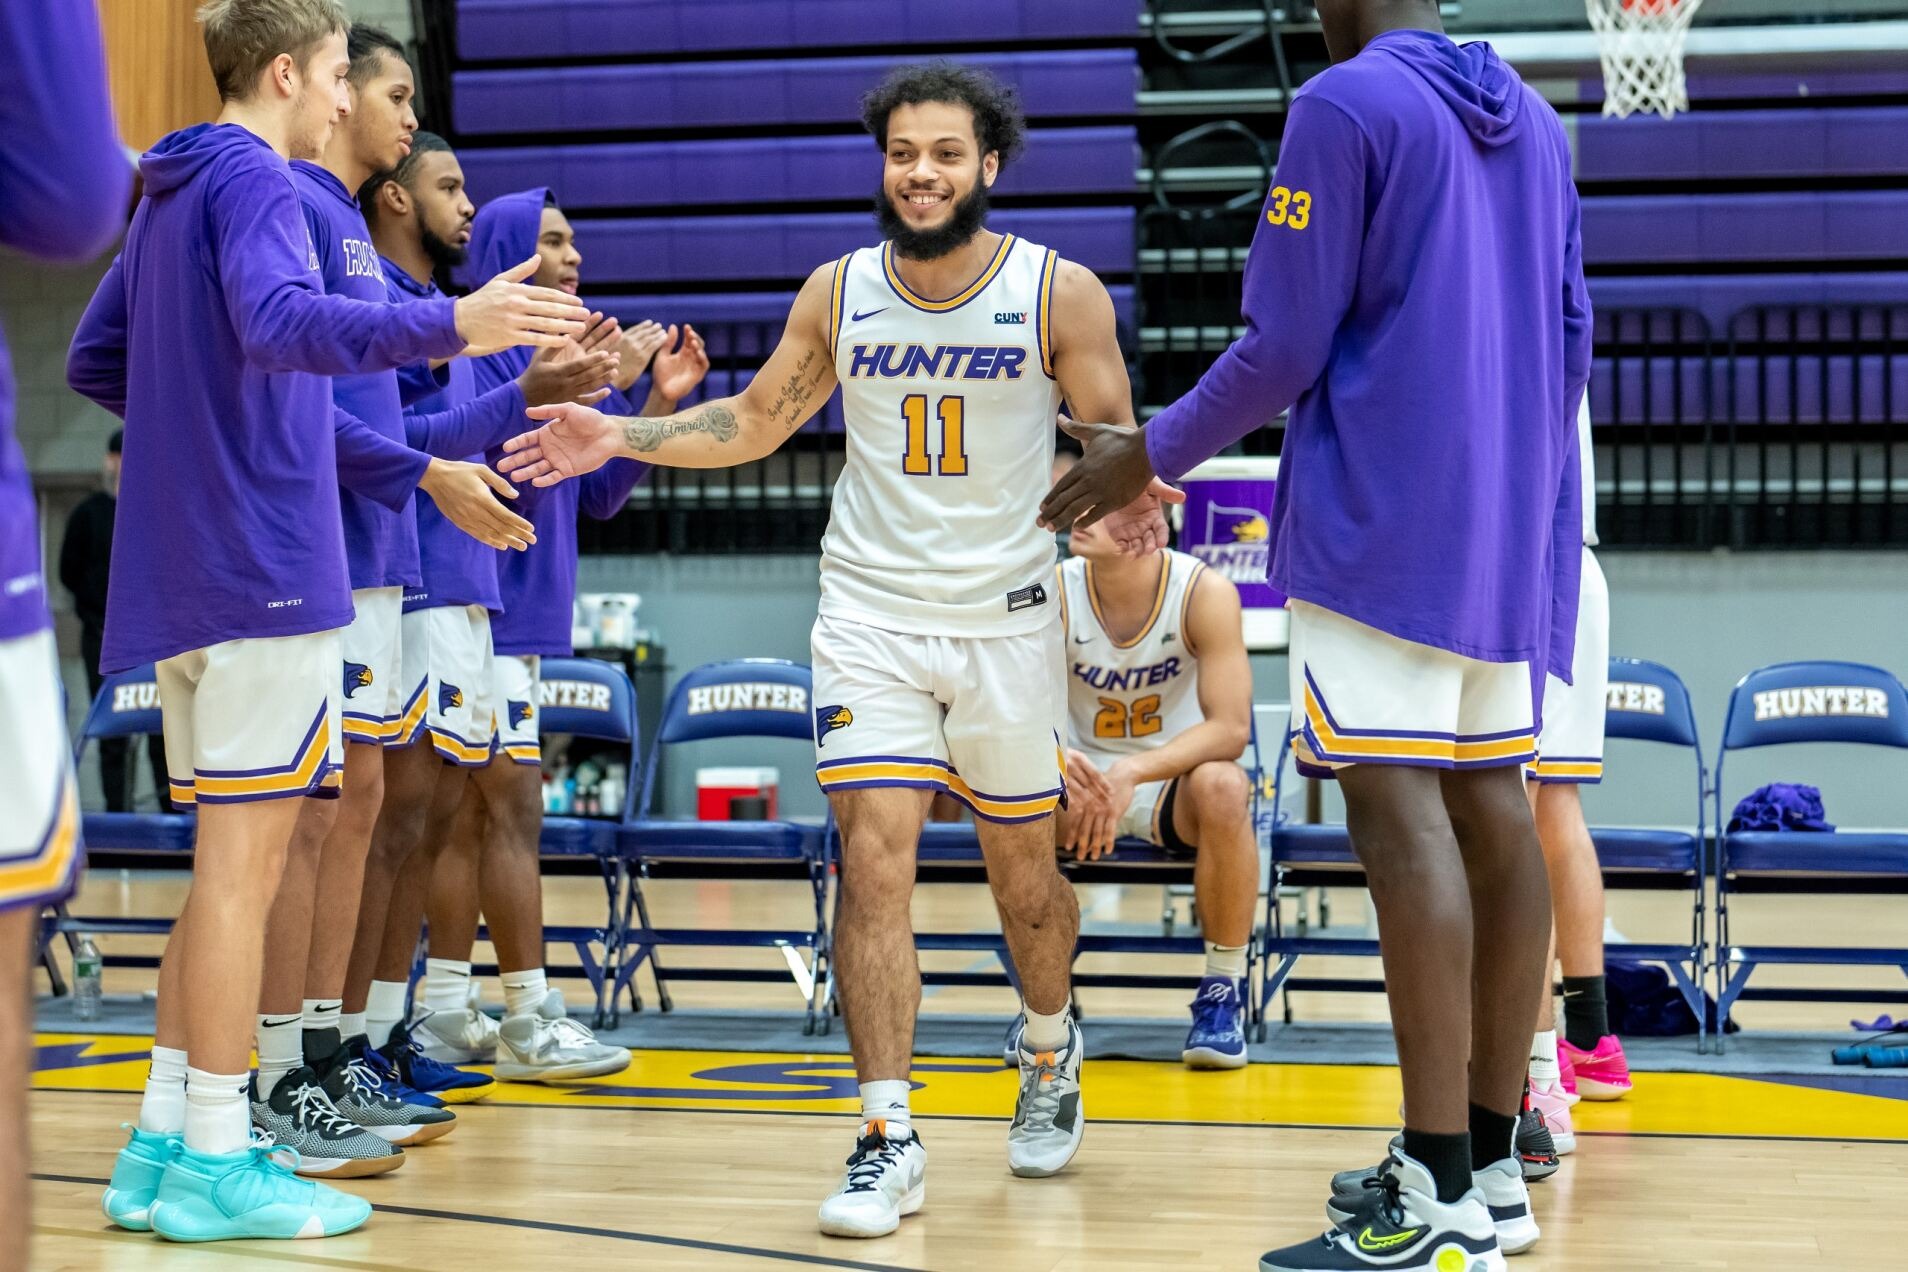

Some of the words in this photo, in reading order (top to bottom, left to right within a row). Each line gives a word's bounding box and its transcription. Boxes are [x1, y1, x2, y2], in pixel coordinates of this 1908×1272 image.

[1267, 186, 1312, 230] 33
[994, 312, 1028, 324] CUNY
[849, 343, 1029, 381] HUNTER
[901, 393, 968, 476] 11
[268, 598, 303, 608] DRI-FIT
[1035, 590, 1043, 600] M
[1074, 656, 1182, 691] HUNTER
[540, 680, 611, 712] NTER
[688, 682, 807, 715] HUNTER
[1606, 681, 1665, 714] TER
[1754, 686, 1888, 721] HUNTER
[1093, 694, 1162, 738] 22
